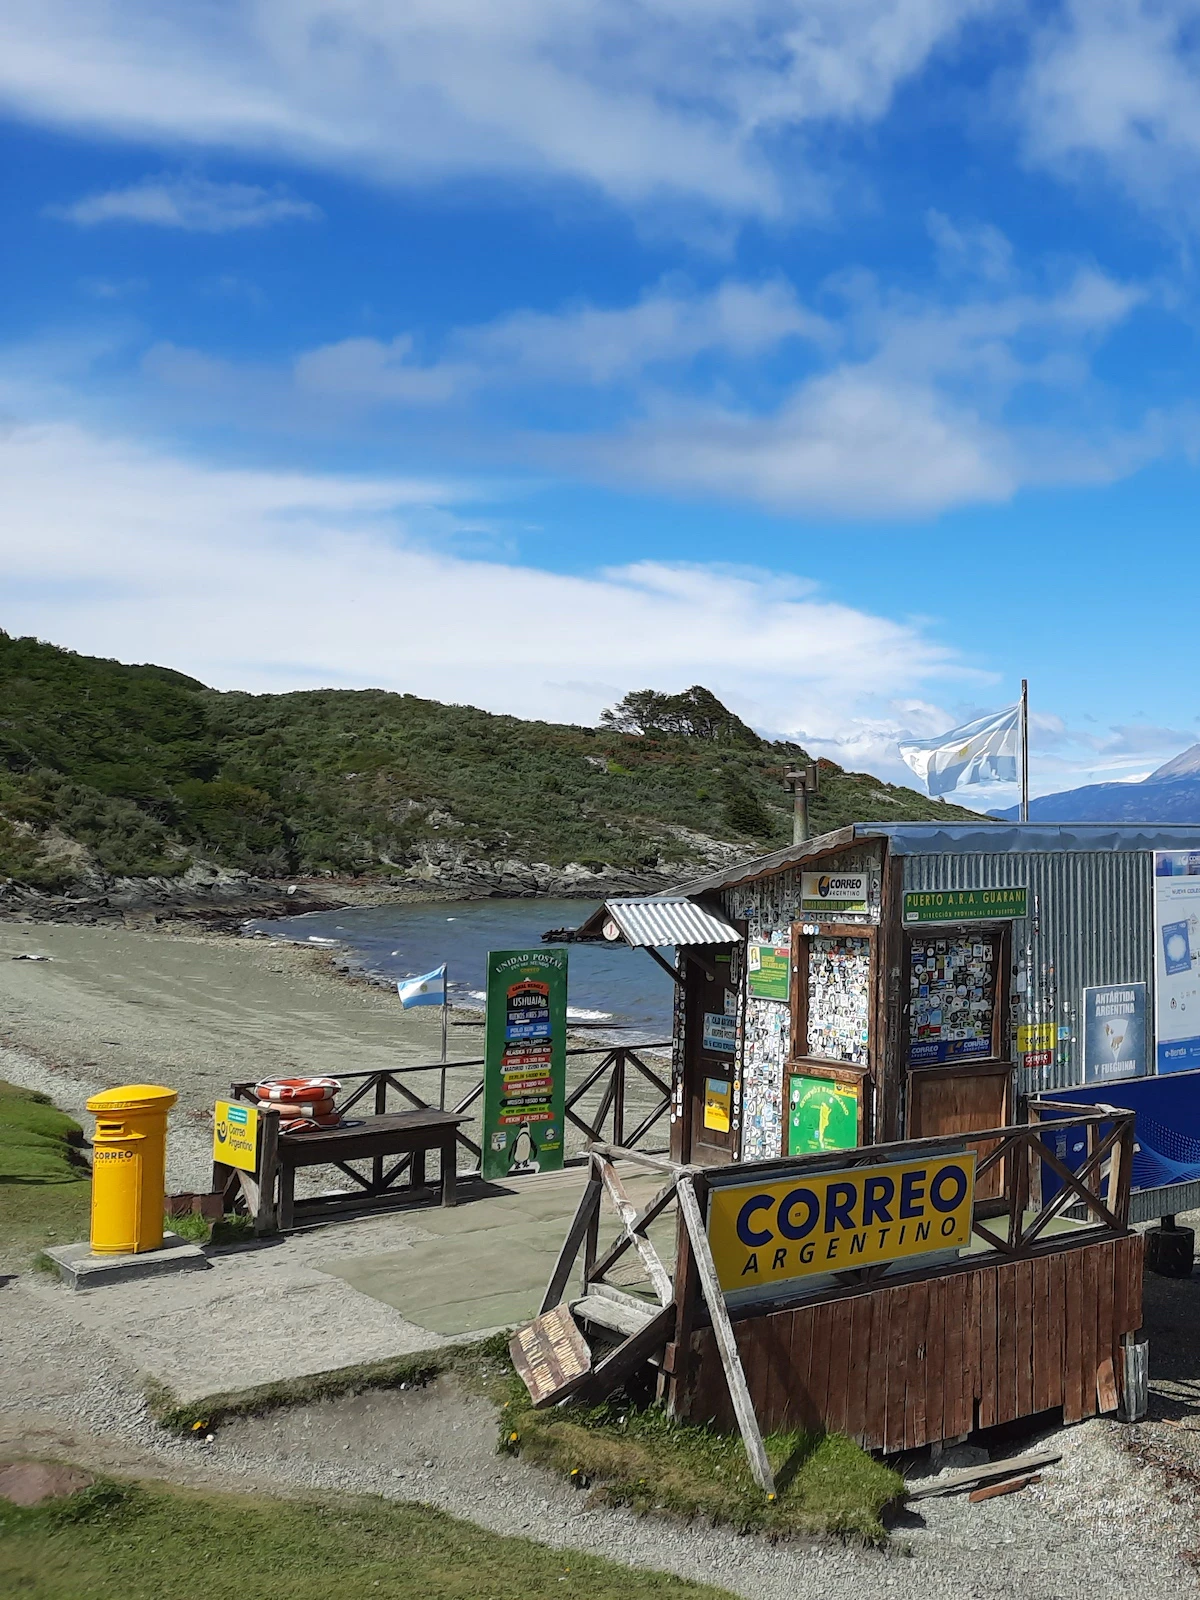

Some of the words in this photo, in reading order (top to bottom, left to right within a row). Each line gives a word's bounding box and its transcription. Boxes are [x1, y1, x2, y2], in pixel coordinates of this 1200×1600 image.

[830, 879, 862, 889] CORREO
[907, 894, 943, 907] PUERTO
[948, 893, 979, 905] A.R.A.
[983, 890, 1025, 903] GUARANI
[923, 911, 952, 919] DIRECCIÓN
[954, 909, 985, 917] PROVINCIAL
[496, 954, 528, 974] UNIDAD
[533, 954, 563, 970] POSTAL
[1095, 990, 1135, 1005] ANTÁRTIDA
[1095, 1003, 1135, 1017] ARGENTINA
[911, 1045, 939, 1054] CORREO
[963, 1039, 989, 1048] CORREO
[1094, 1065, 1100, 1075] Y
[228, 1123, 246, 1137] Correo
[228, 1136, 253, 1152] Argentino
[95, 1150, 133, 1160] CORREO
[736, 1165, 968, 1247] CORREO
[741, 1216, 957, 1277] ARGENTINO
